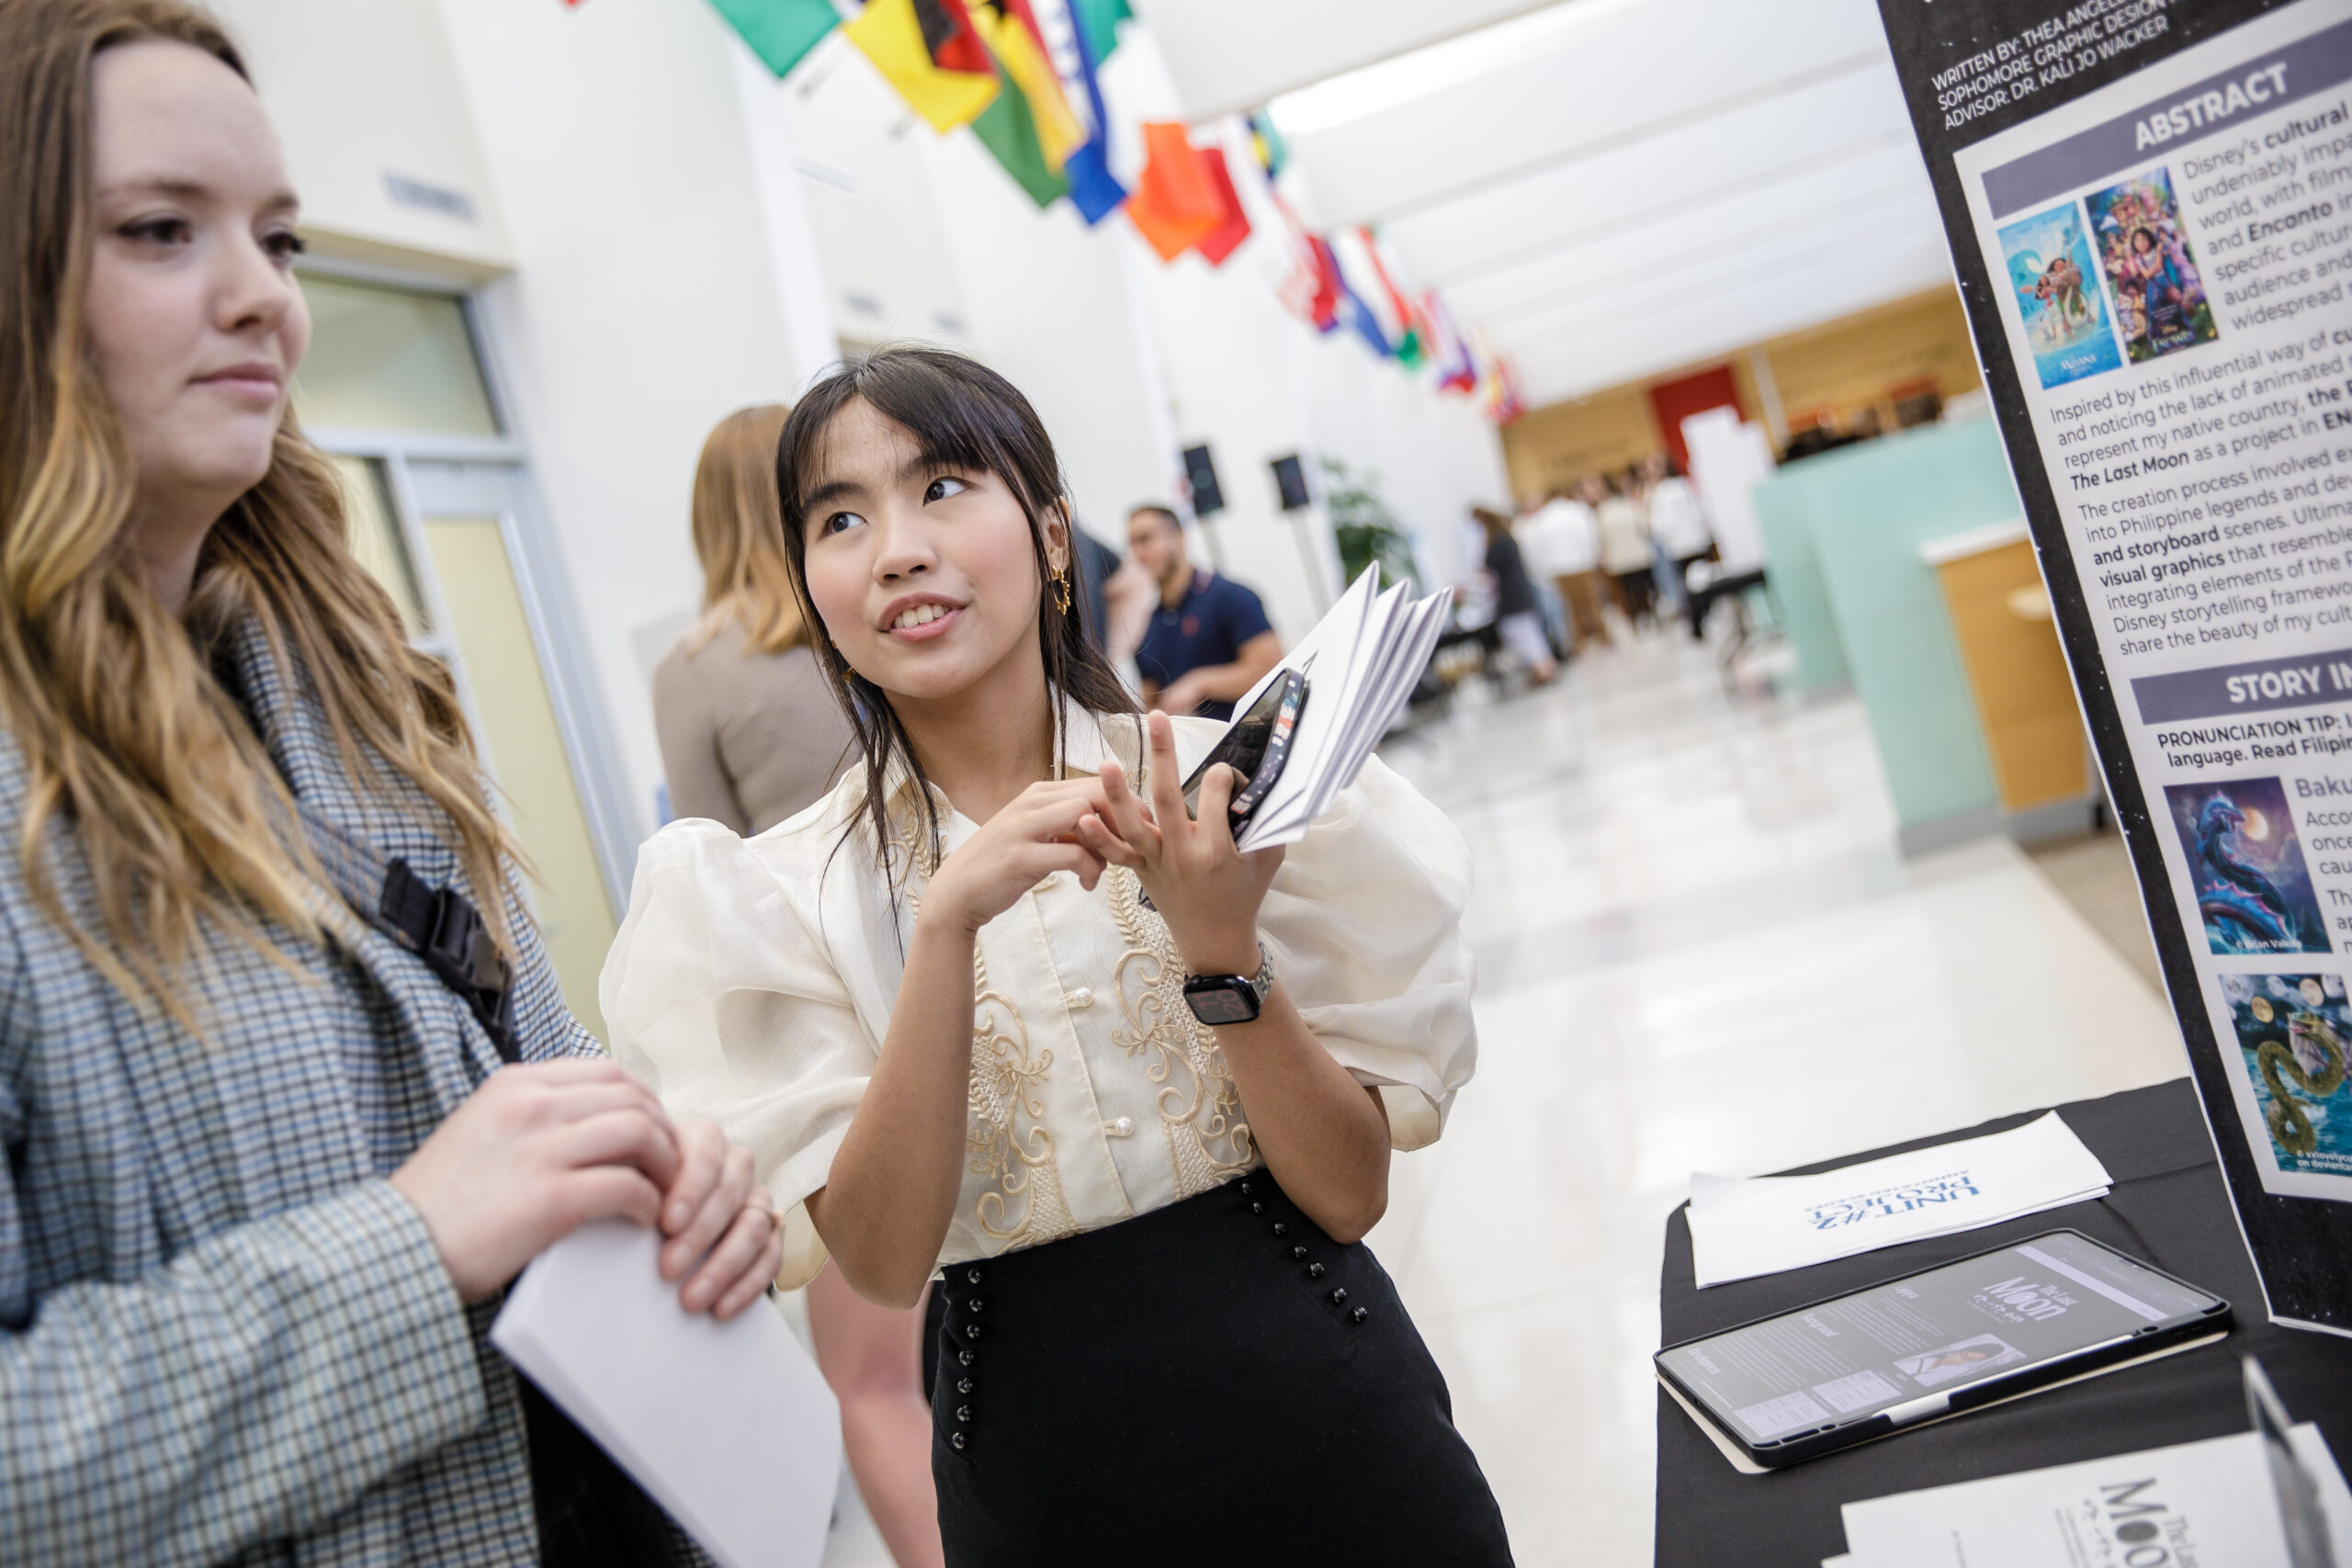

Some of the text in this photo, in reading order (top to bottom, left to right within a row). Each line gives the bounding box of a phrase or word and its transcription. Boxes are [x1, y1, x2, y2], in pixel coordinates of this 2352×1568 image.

[1931, 50, 1995, 91] WRITTEN
[1996, 39, 2022, 62] BY:
[2021, 17, 2065, 47] THEA
[1938, 0, 2167, 110] SOPHOMORE GRAPHIC DESIGN
[1945, 15, 2169, 130] ADVISOR: DR. KALI JO WACKER
[2134, 62, 2289, 150] ABSTRACT
[2183, 100, 2348, 180] Disney's cultural
[2192, 154, 2297, 205] undeniably
[2199, 197, 2258, 230] world,
[2261, 181, 2305, 208] with
[2208, 229, 2243, 255] and
[2248, 203, 2333, 242] Encanto
[2215, 246, 2287, 282] specific
[2224, 267, 2311, 306] audience
[2232, 281, 2344, 330] widespread
[2051, 392, 2113, 423] Inspired
[2115, 389, 2136, 407] by
[2140, 377, 2172, 399] this
[2173, 349, 2263, 389] influential
[2267, 341, 2304, 364] way
[2310, 330, 2327, 351] of
[2058, 424, 2086, 446] and
[2090, 410, 2156, 438] noticing
[2159, 400, 2188, 419] the
[2190, 387, 2228, 411] lack
[2231, 379, 2248, 400] of
[2253, 355, 2344, 394] animated
[2064, 436, 2139, 468] represent
[2143, 432, 2167, 450] my
[2171, 417, 2224, 442] native
[2228, 399, 2305, 427] country,
[2307, 387, 2342, 407] the
[2070, 473, 2099, 491] The
[2104, 462, 2140, 483] Last
[2143, 451, 2189, 474] Moon
[2194, 446, 2212, 462] as
[2216, 443, 2227, 457] a
[2232, 423, 2298, 457] project
[2300, 419, 2320, 436] in
[2078, 502, 2109, 520] The
[2112, 487, 2177, 513] creation
[2181, 471, 2249, 502] process
[2250, 447, 2332, 482] involved
[2085, 526, 2117, 543] into
[2120, 507, 2203, 536] Philippine
[2205, 489, 2278, 518] legends
[2283, 478, 2319, 502] and
[2093, 545, 2123, 566] and
[2127, 525, 2220, 558] storyboard
[2223, 514, 2290, 540] scenes.
[2099, 564, 2147, 587] visual
[2151, 552, 2226, 582] graphics
[2228, 543, 2267, 564] that
[2106, 582, 2199, 611] integrating
[2201, 567, 2284, 594] elements
[2288, 558, 2304, 579] of
[2308, 556, 2341, 575] the
[2113, 613, 2166, 633] Disney
[2171, 594, 2268, 624] storytelling
[2120, 637, 2164, 656] share
[2166, 631, 2196, 649] the
[2199, 621, 2259, 644] beauty
[2264, 614, 2279, 633] of
[2284, 614, 2312, 632] my
[2225, 665, 2322, 704] STORY
[2158, 719, 2303, 749] PRONUNCIATION
[2305, 714, 2342, 733] TIP:
[2167, 748, 2248, 769] language.
[2251, 739, 2299, 760] Read
[2297, 1159, 2311, 1168] on
[1808, 1177, 1971, 1224] PROJECT
[1813, 1186, 1980, 1229] UNIT #2
[1982, 1276, 2067, 1321] Moon
[2163, 1516, 2189, 1544] The
